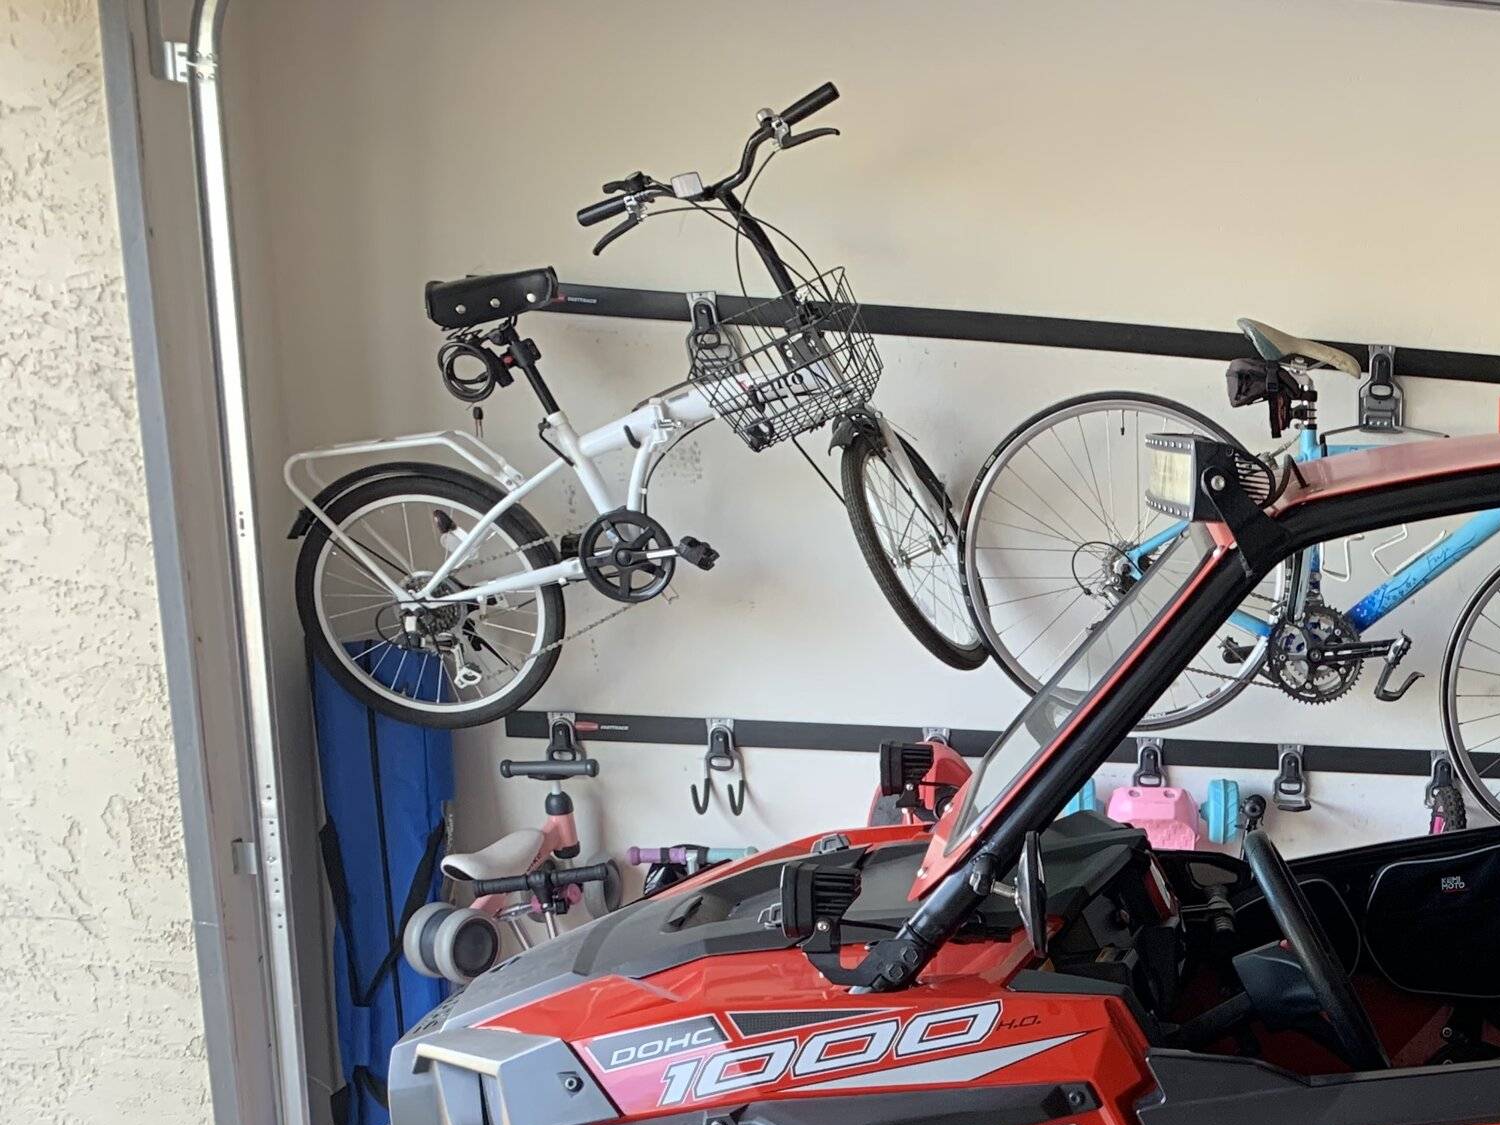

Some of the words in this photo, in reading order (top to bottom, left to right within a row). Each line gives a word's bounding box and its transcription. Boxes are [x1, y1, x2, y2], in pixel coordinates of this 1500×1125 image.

[609, 1026, 715, 1067] DOHC
[657, 999, 1004, 1107] 1000
[997, 1014, 1042, 1033] H.O.
